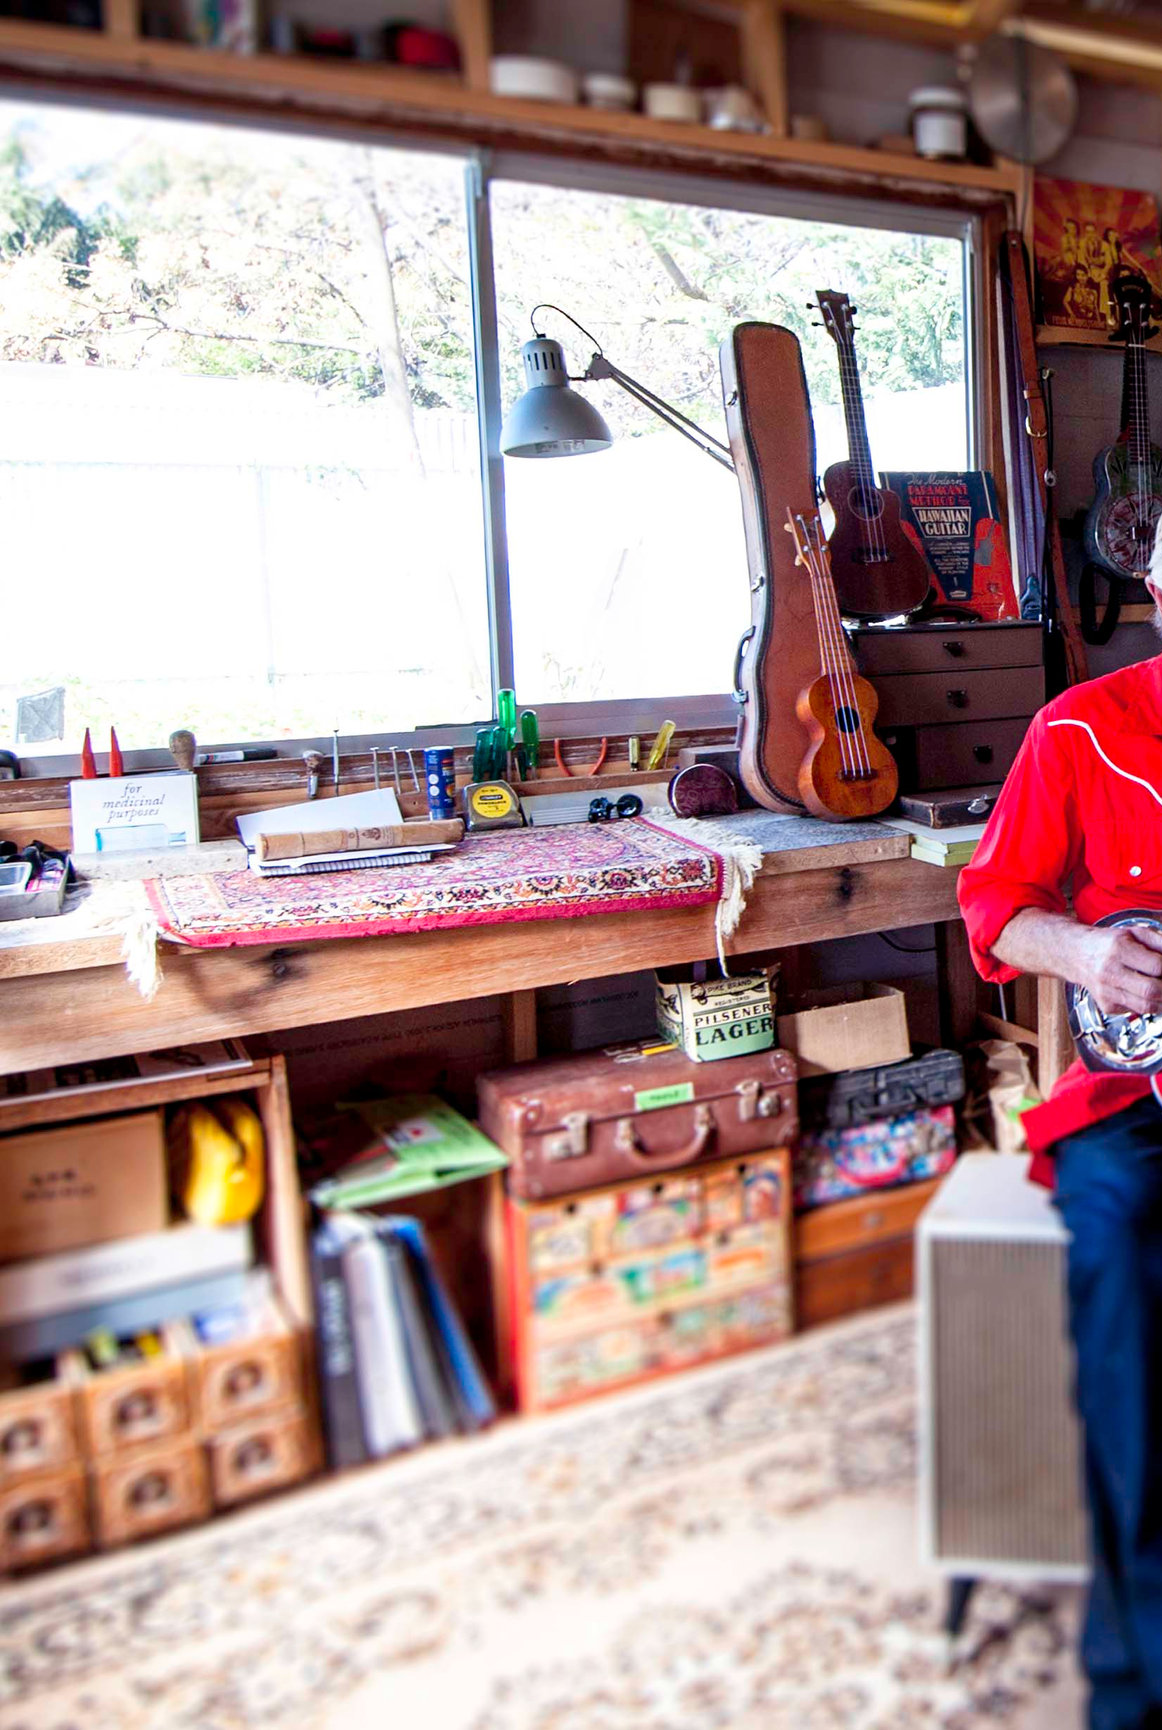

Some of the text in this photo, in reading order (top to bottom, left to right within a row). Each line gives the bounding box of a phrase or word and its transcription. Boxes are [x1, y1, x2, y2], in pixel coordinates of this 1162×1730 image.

[918, 509, 969, 523] HAWAIIAN
[925, 522, 967, 535] GUITAR
[121, 782, 142, 798] for
[102, 794, 166, 808] medicinal
[107, 808, 160, 823] purposes
[694, 1003, 772, 1027] PILSENER
[696, 1017, 773, 1046] LAGER
